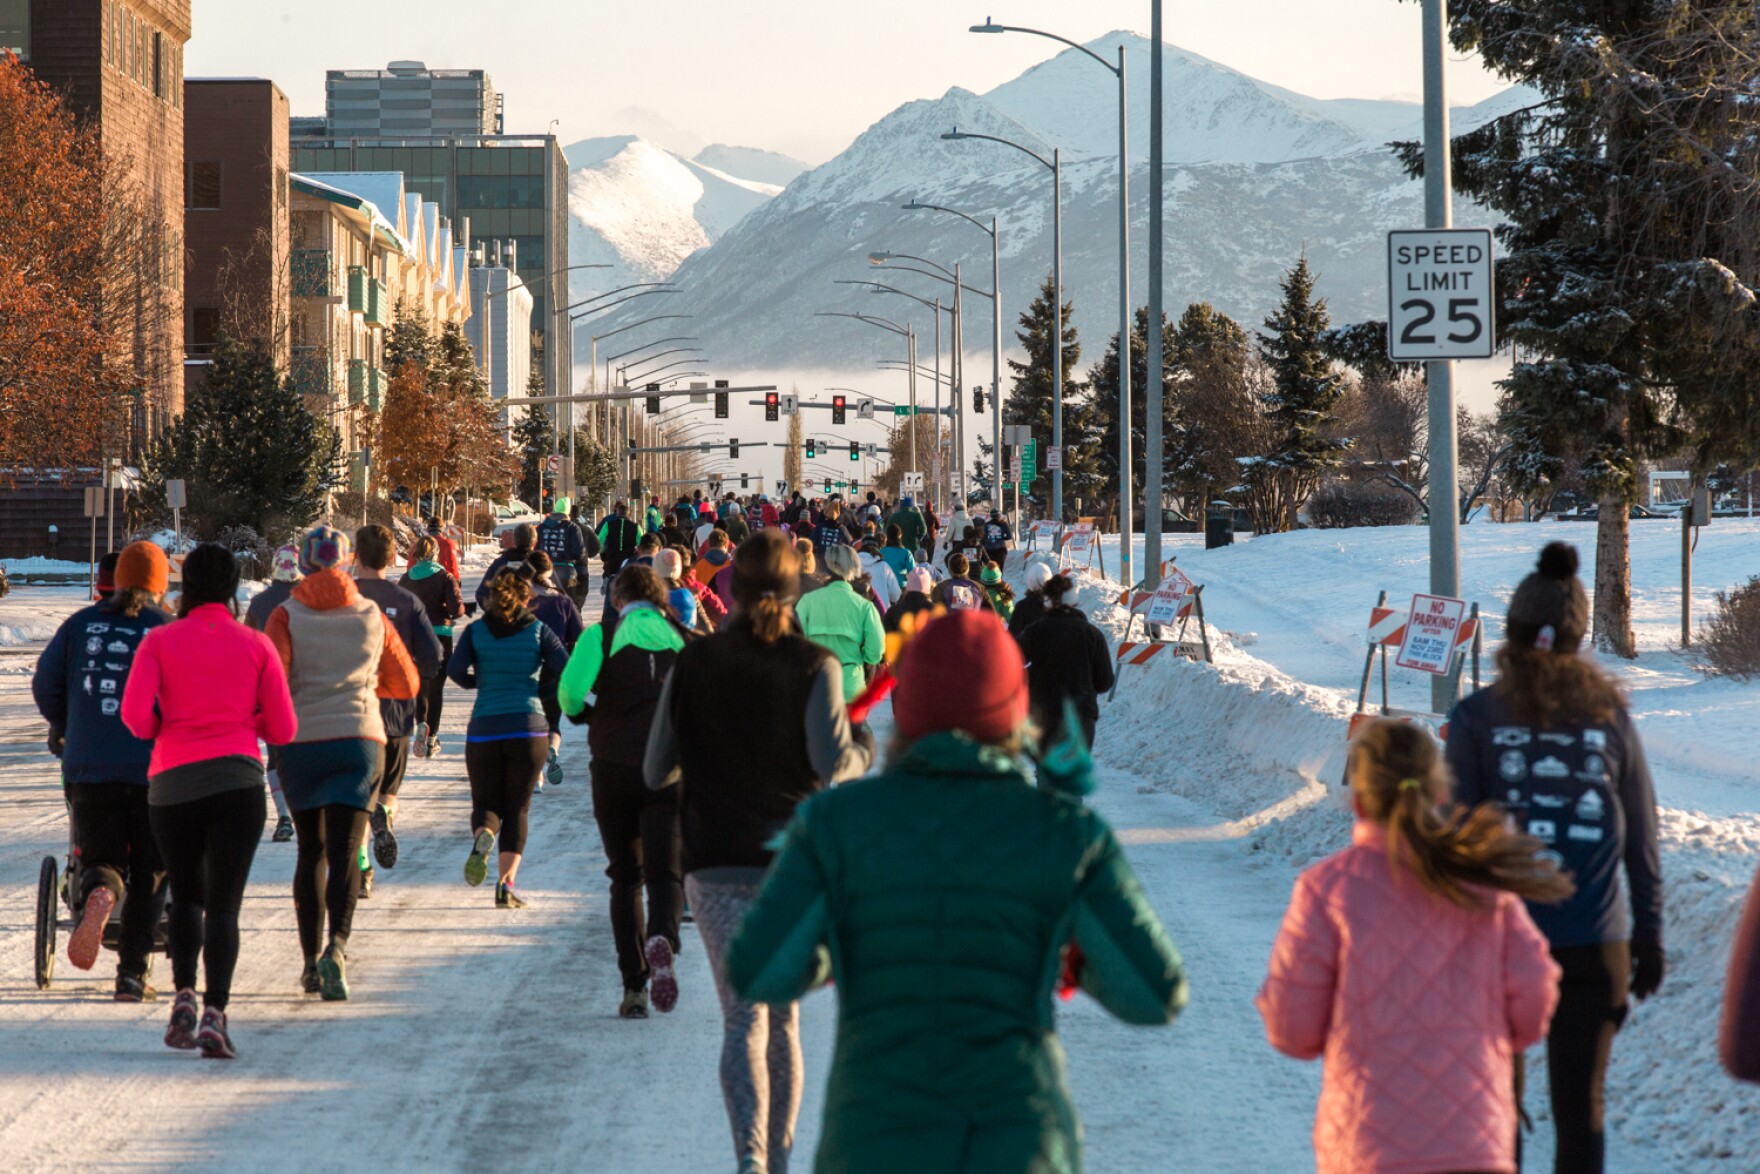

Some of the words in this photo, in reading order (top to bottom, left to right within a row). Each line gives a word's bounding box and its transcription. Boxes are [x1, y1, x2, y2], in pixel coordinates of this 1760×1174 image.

[1397, 245, 1482, 264] SPEED
[1408, 272, 1473, 291] LIMIT
[1400, 298, 1482, 344] 25
[1156, 590, 1182, 600] PARKING
[1431, 601, 1445, 614] NO
[1413, 613, 1456, 629] PARKING
[1432, 639, 1448, 647] THU
[1422, 652, 1442, 660] BLOCK
